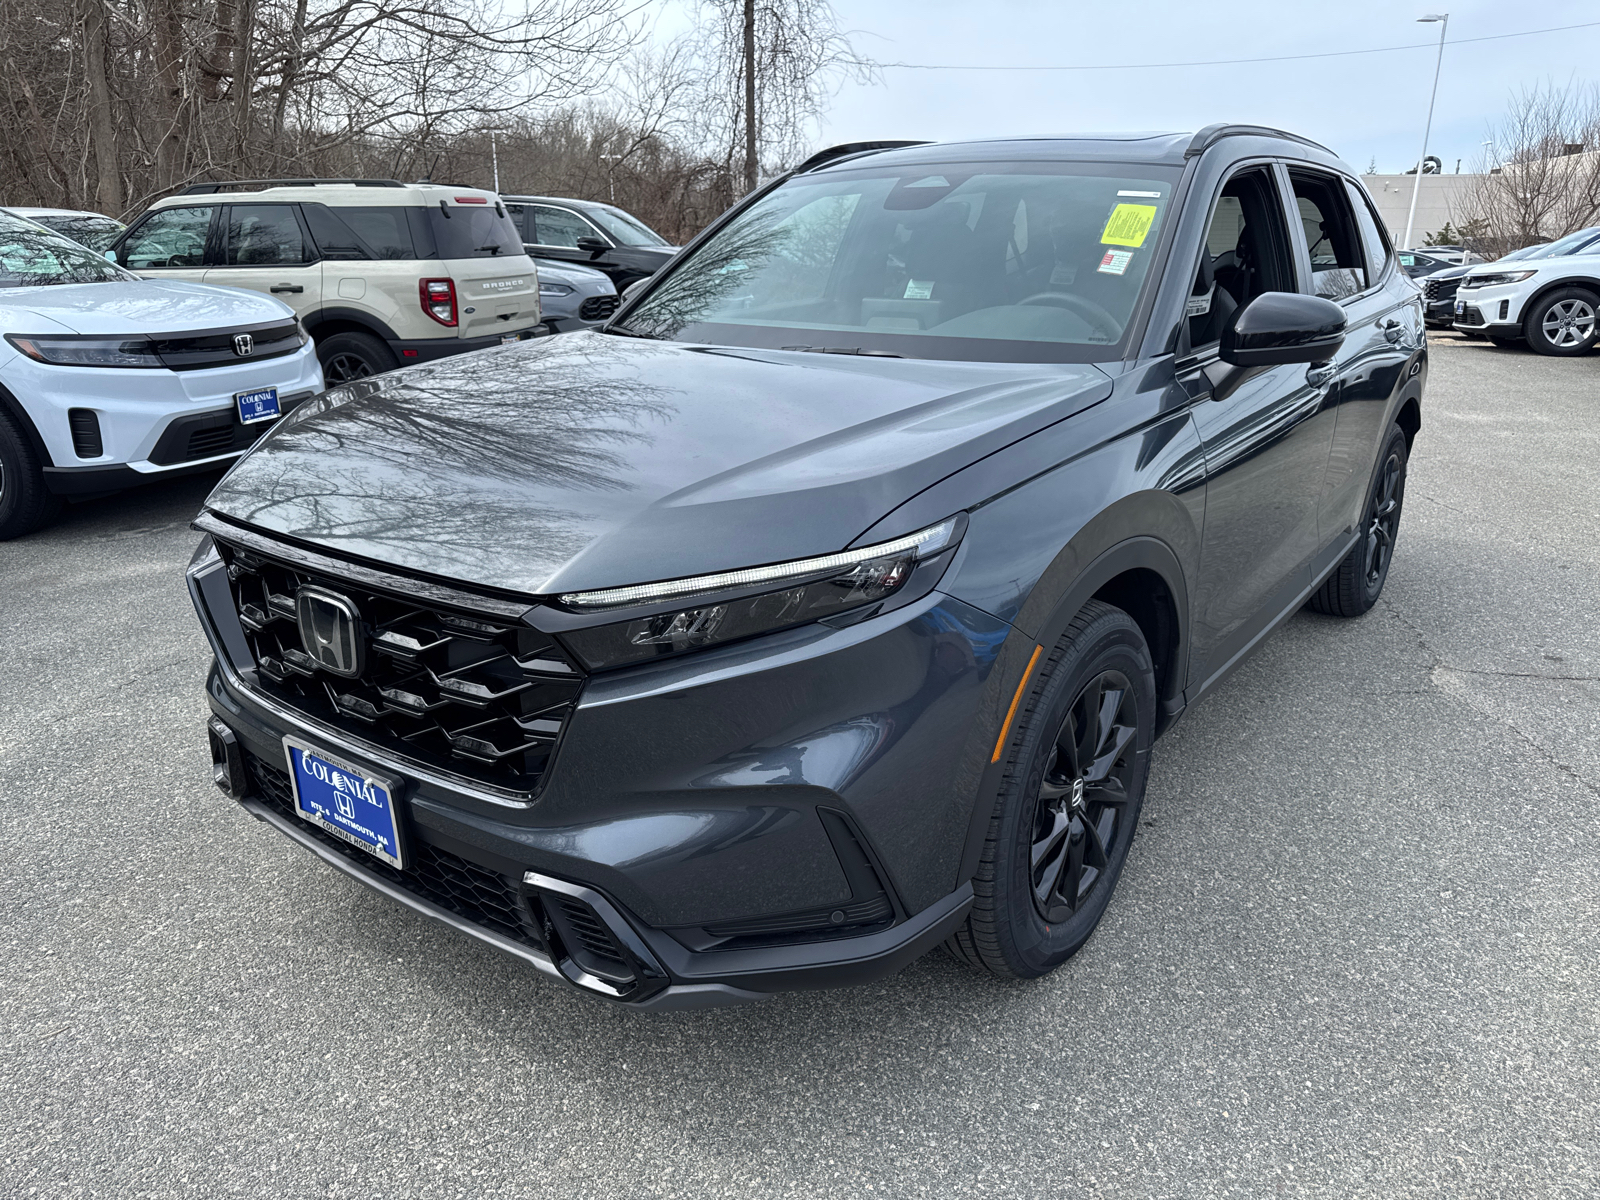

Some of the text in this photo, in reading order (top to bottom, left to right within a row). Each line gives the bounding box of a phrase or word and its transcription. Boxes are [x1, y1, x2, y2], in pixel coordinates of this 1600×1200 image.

[482, 280, 524, 289] BRONCO
[302, 756, 383, 809] COLONIAL
[322, 821, 377, 856] COLONIAL HONDA
[377, 834, 389, 846] MA
